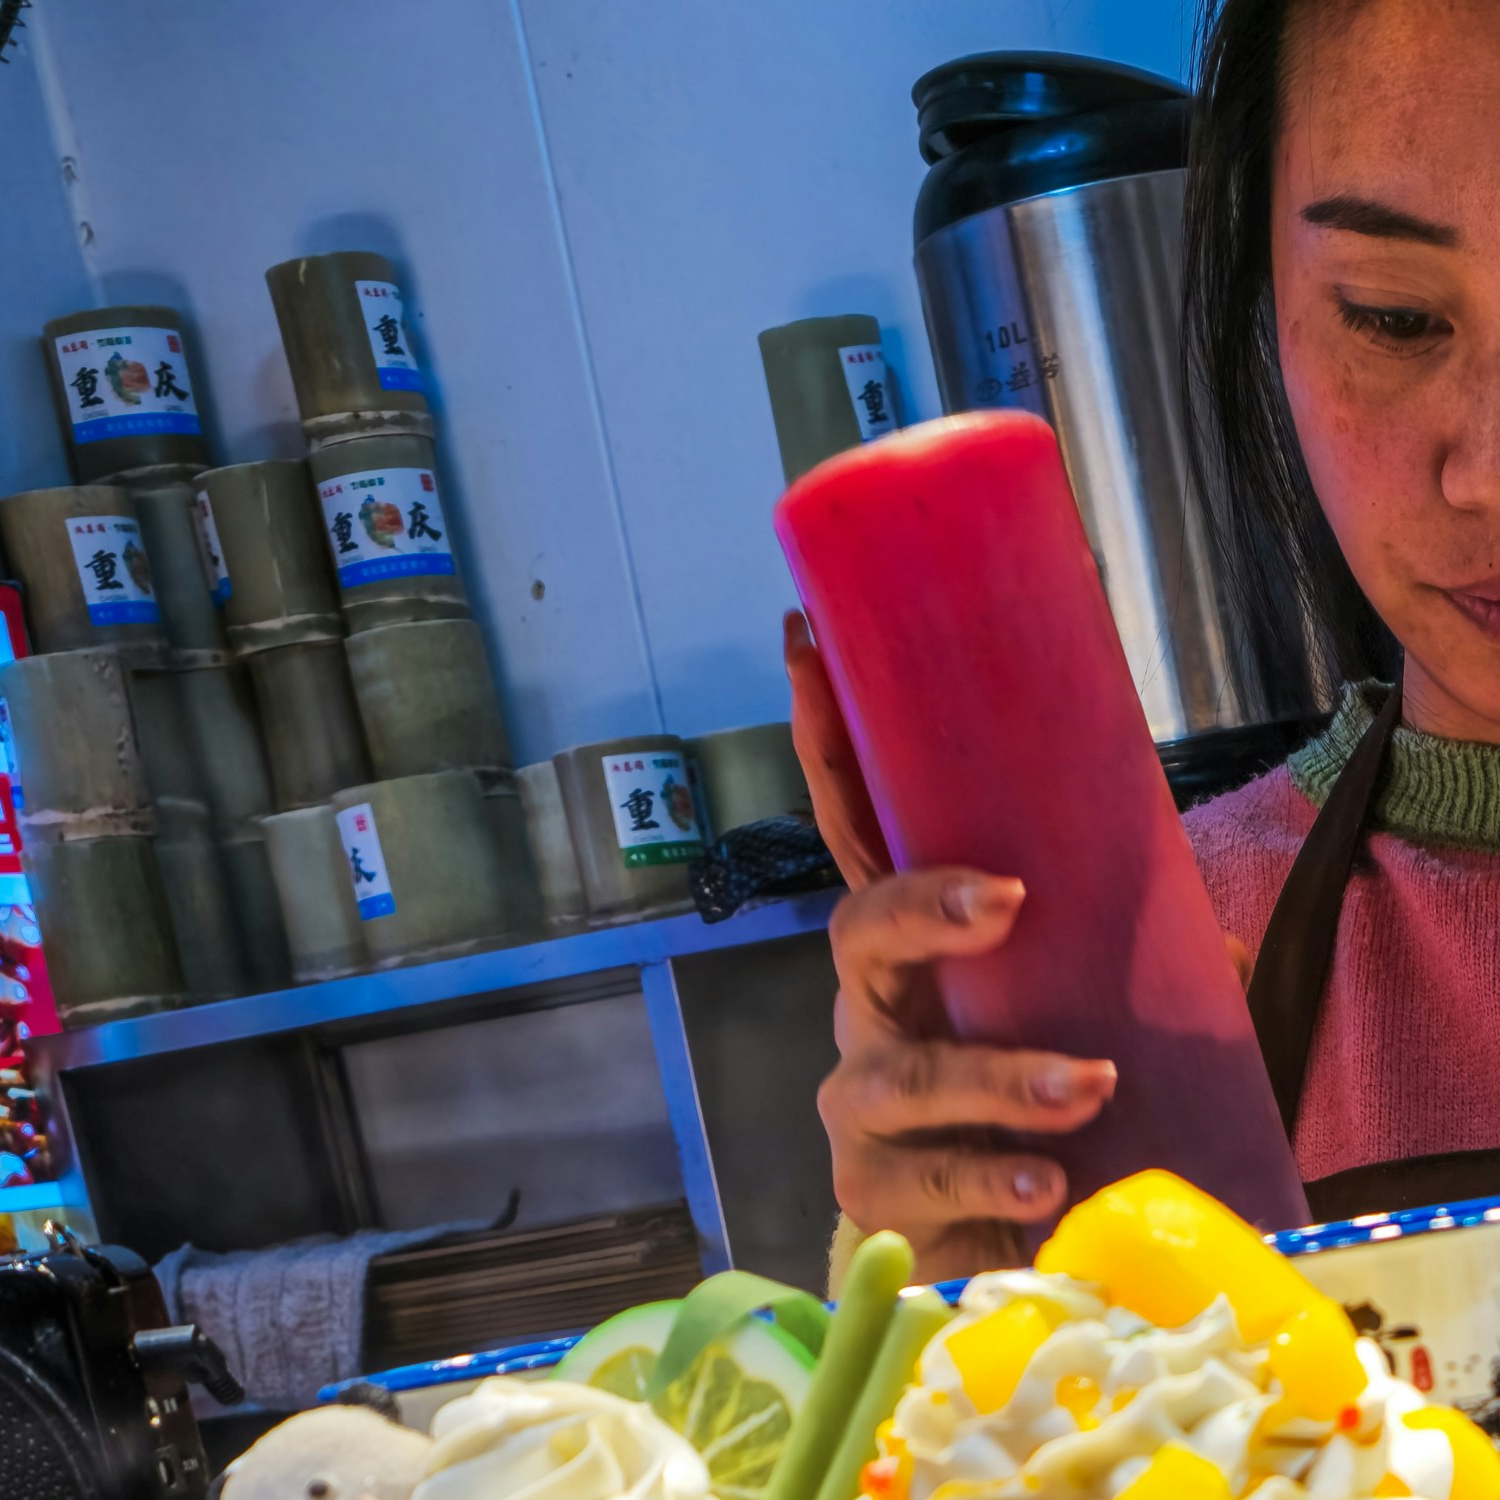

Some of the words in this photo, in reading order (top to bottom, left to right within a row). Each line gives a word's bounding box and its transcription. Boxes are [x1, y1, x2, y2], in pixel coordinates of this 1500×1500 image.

[373, 314, 405, 355] 重
[985, 322, 1028, 353] 10L
[70, 367, 104, 408] 重
[154, 360, 190, 401] 庆
[857, 380, 890, 425] 重
[331, 512, 358, 554] 重
[408, 501, 442, 542] 庆
[84, 549, 124, 590] 重
[620, 788, 660, 832] 重
